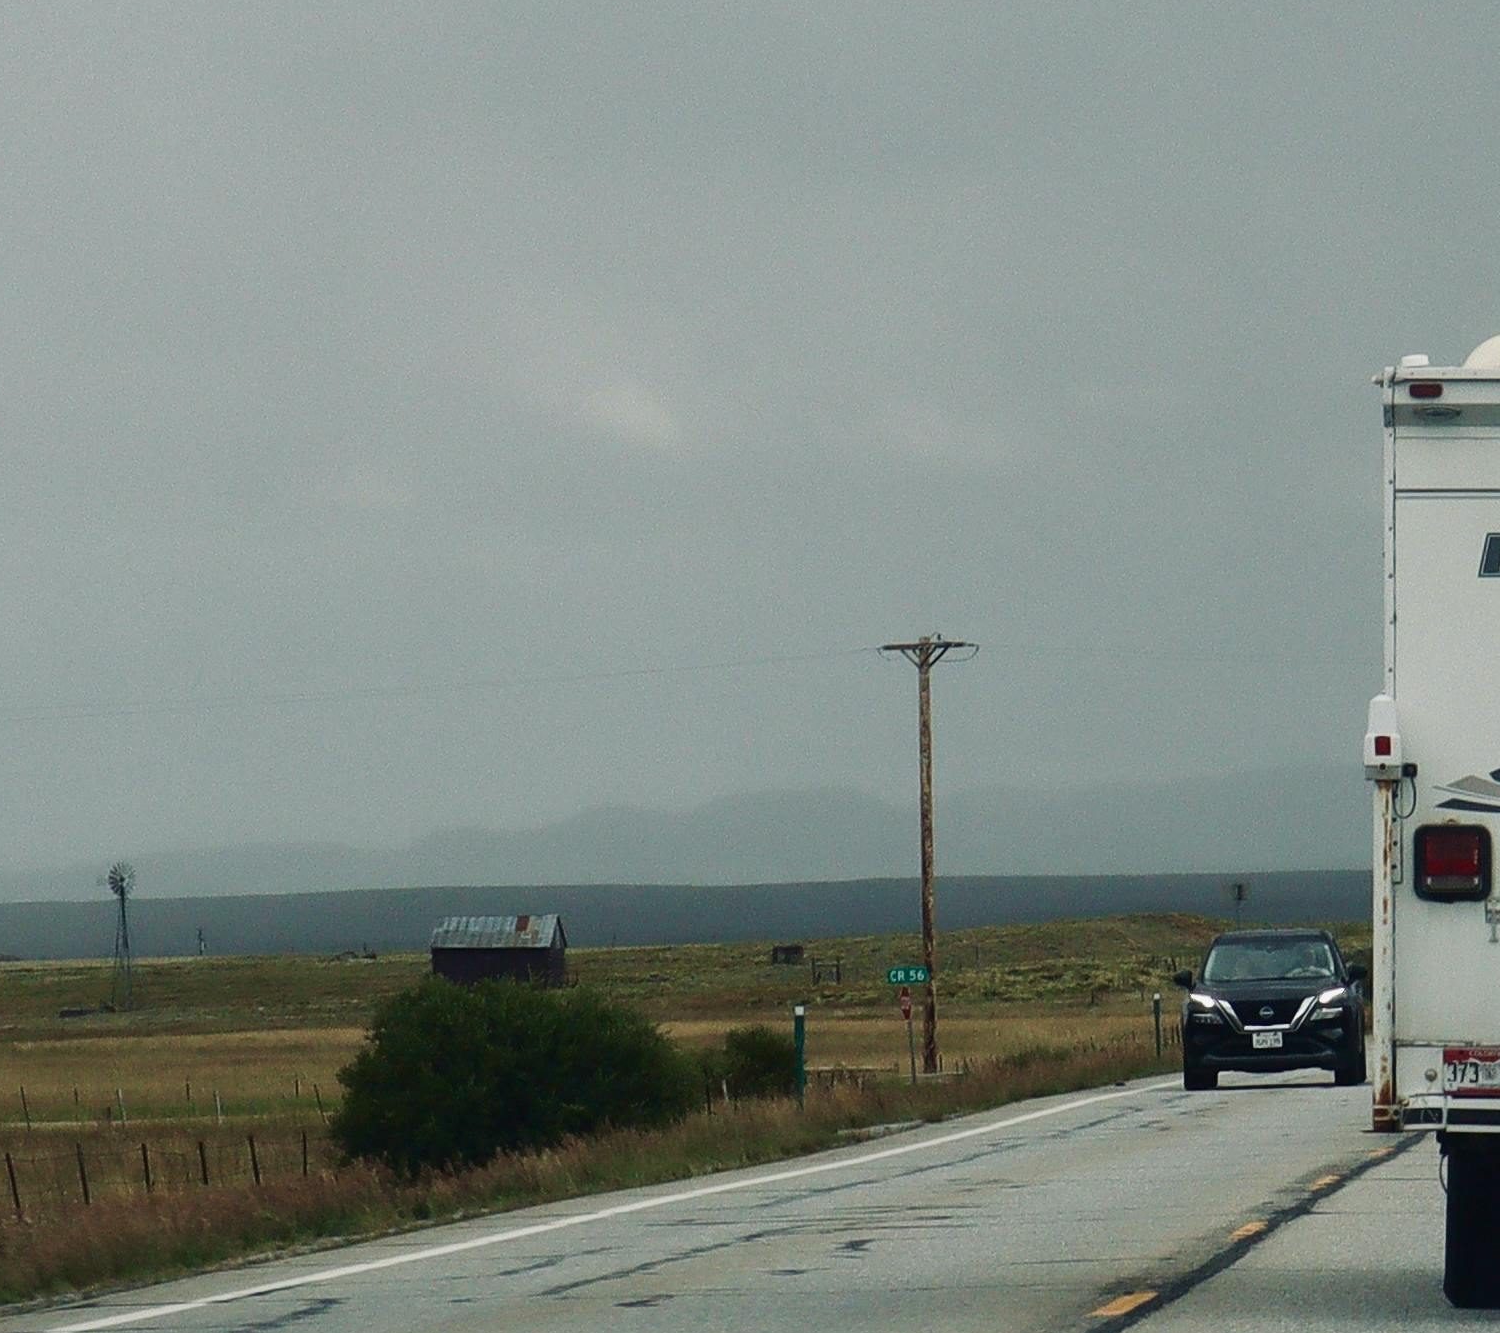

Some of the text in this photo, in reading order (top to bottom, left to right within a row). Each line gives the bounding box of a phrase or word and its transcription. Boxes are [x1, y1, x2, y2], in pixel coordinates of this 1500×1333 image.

[890, 969, 925, 983] CR 56
[1446, 1061, 1479, 1083] 373
